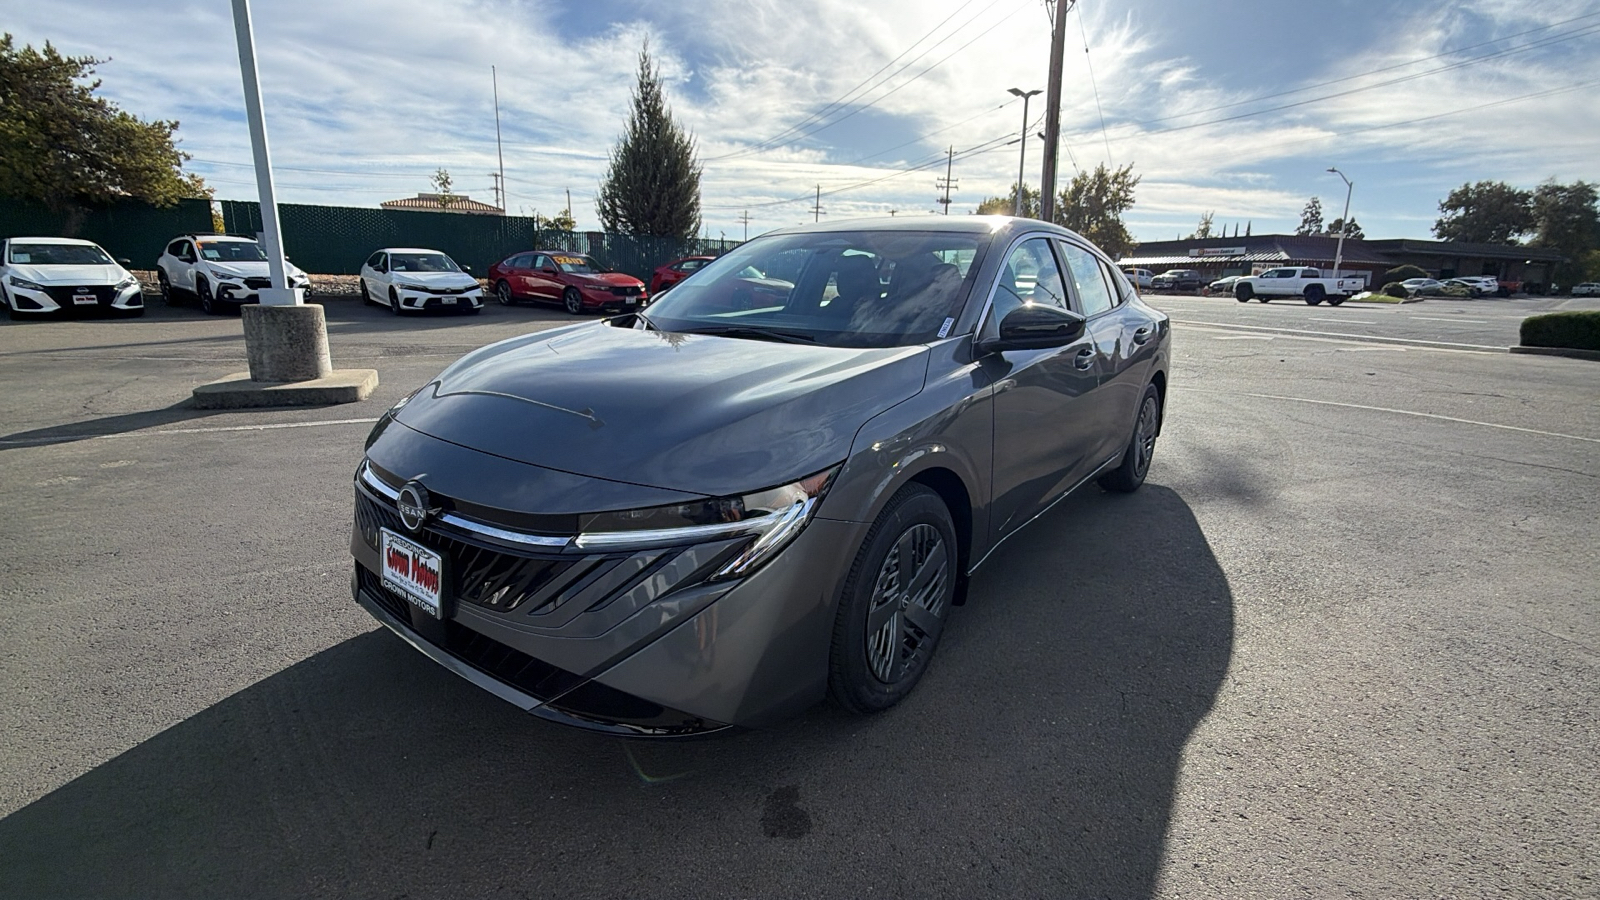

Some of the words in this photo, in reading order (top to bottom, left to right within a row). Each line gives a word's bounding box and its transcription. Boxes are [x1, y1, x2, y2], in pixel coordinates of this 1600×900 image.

[392, 535, 425, 557] REDDING
[386, 546, 410, 578] Crown
[411, 550, 439, 596] Motors
[383, 579, 407, 600] CROWN
[407, 591, 436, 616] MOTORS
